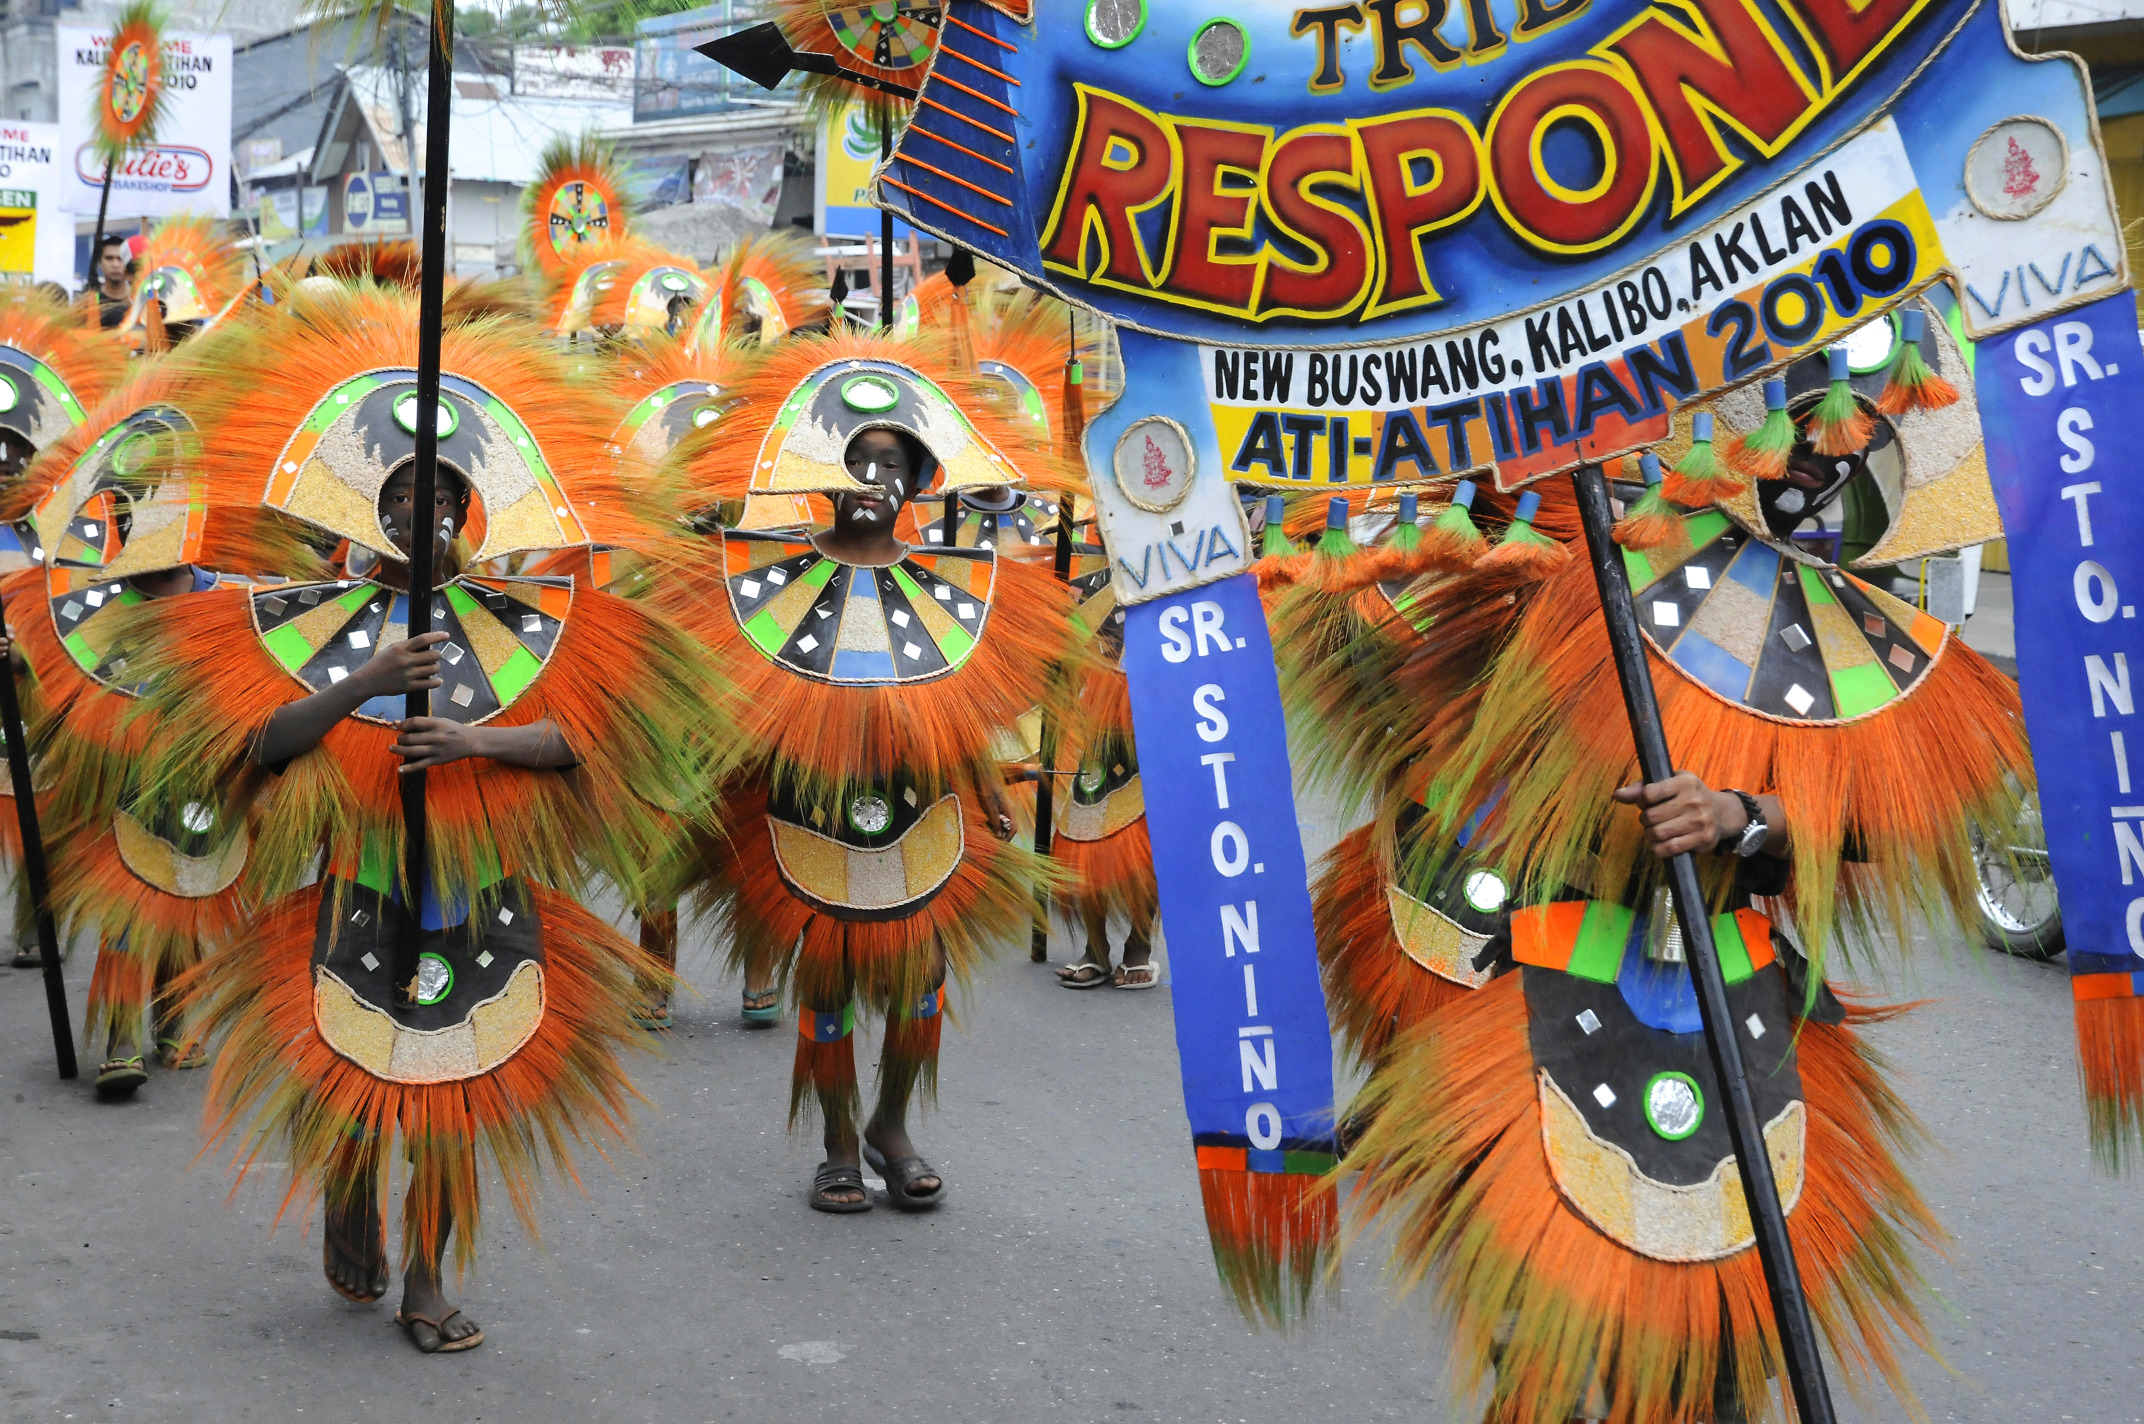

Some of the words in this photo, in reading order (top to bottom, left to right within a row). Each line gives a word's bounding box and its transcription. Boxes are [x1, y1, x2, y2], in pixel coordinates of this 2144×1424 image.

[1214, 349, 1294, 403] NEW
[1306, 327, 1523, 407] BUSWANG,
[1525, 266, 1691, 374] KALIBO,
[1690, 170, 1852, 311] AKLAN
[1965, 243, 2117, 317] VIVA
[1231, 328, 1699, 482] ATI-ATIHAN
[1706, 219, 1917, 382] 2010
[2014, 320, 2119, 396] SR.
[1118, 524, 1240, 589] VIVA
[1158, 600, 1247, 663] SR.
